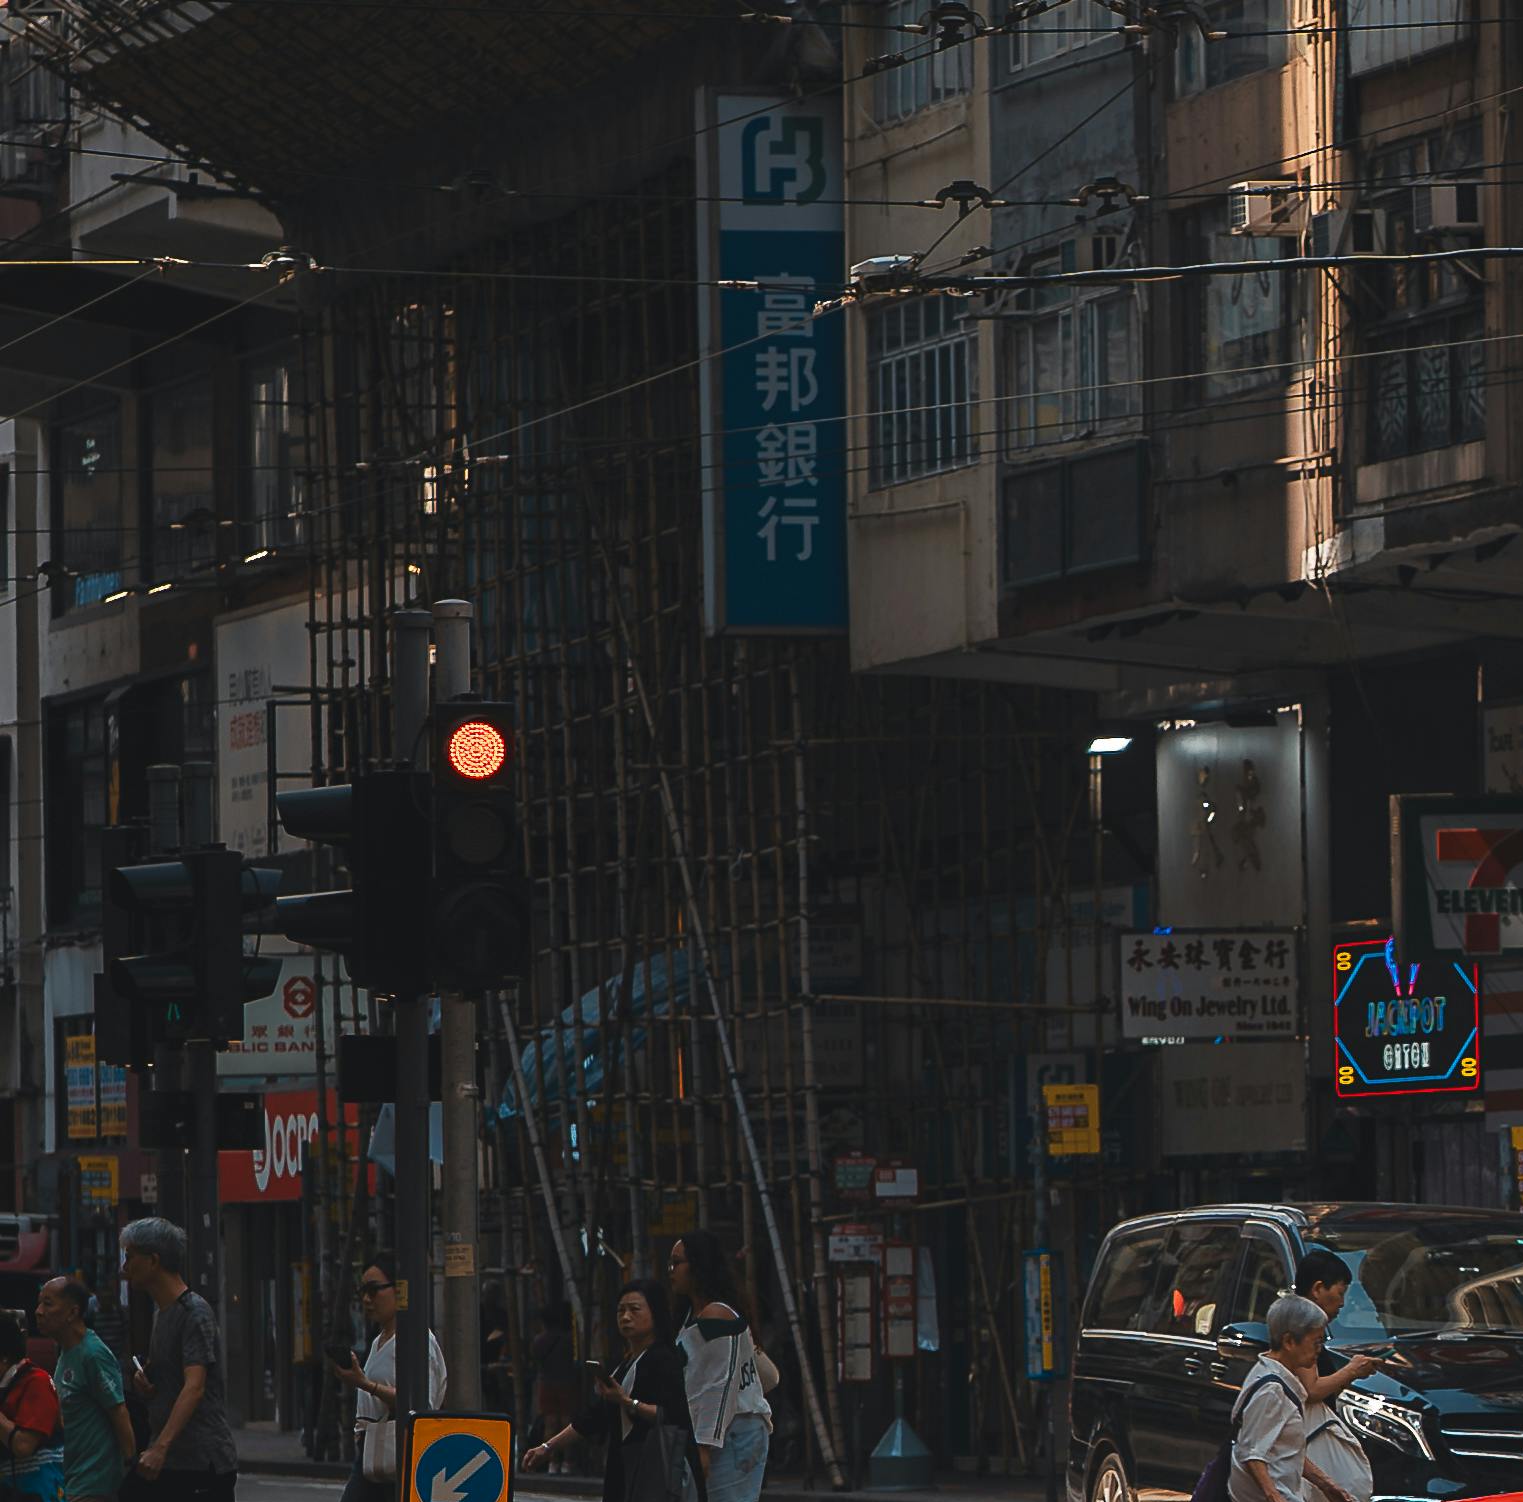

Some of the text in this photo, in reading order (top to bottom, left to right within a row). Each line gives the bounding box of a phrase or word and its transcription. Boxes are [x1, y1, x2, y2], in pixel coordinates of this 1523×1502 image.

[753, 272, 822, 564] 富邦銀行
[1127, 938, 1290, 972] 永安珠寶金行
[1128, 994, 1292, 1021] Wing On Jewelry Ltd.
[1365, 996, 1447, 1038] JACKPOT
